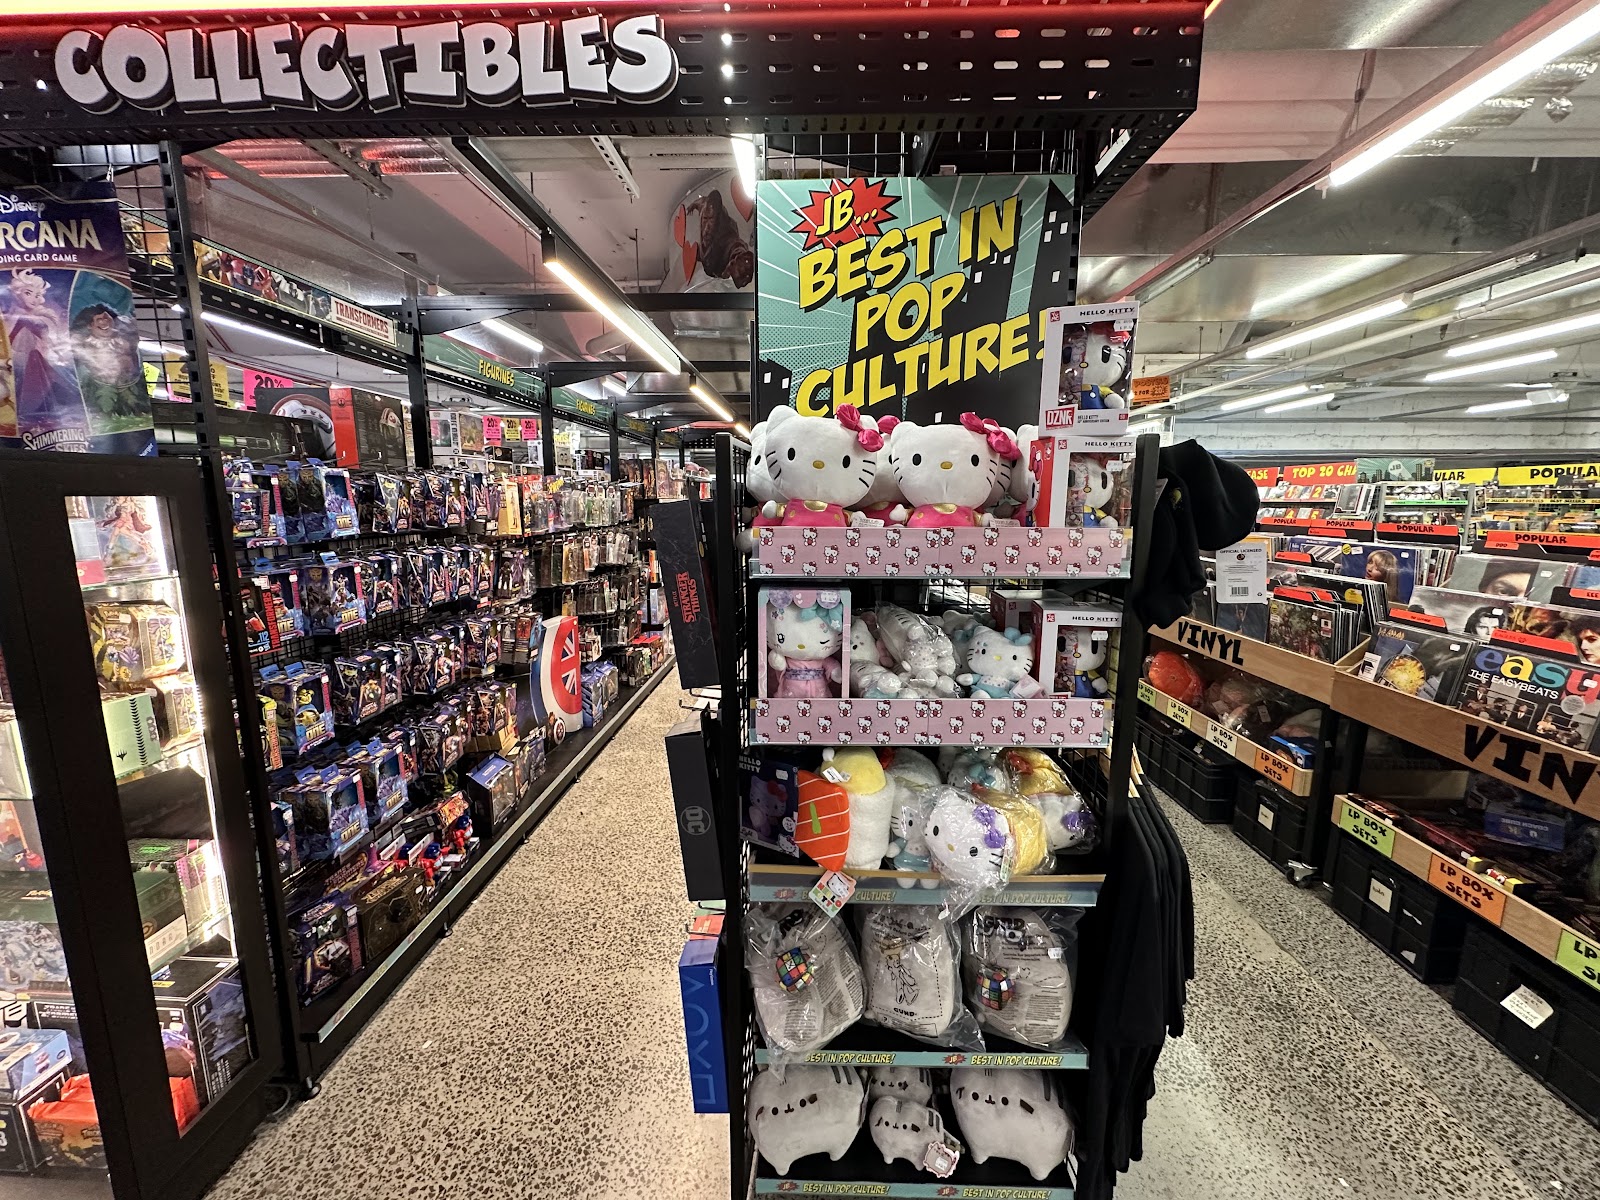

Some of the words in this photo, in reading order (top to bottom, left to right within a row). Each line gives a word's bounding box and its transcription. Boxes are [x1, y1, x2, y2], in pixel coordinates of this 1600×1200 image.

[54, 14, 677, 110] COLLECTIBLES
[24, 253, 49, 262] CARD
[52, 253, 78, 262] GAME
[798, 215, 945, 310] BEST
[958, 194, 1020, 264] IN
[335, 300, 389, 333] TRANSFORMERS
[855, 271, 966, 352] POP
[478, 359, 515, 387] FIGURINES
[22, 428, 85, 451] SHIMMERING
[1292, 466, 1315, 479] TOP
[1319, 465, 1334, 477] 20
[1530, 465, 1600, 479] POPULA
[1313, 486, 1322, 498] 2
[1396, 525, 1435, 533] POPULAR
[1515, 533, 1567, 544] POPULAR
[675, 570, 697, 624] STRANGER
[686, 578, 701, 613] THINGS
[262, 591, 280, 649] TRANSFORMERS
[1178, 620, 1244, 666] VINYL
[1469, 669, 1491, 683] THE
[1491, 674, 1560, 700] EASYBEATS
[1170, 701, 1177, 709] LP
[1178, 705, 1189, 716] BOX
[1172, 711, 1185, 723] SETS
[1210, 724, 1218, 733] LP
[1219, 729, 1233, 742] BOX
[1212, 735, 1228, 749] SETS
[738, 762, 761, 774] KITTY
[1261, 752, 1270, 762] LP
[1272, 758, 1289, 773] BOX
[1464, 723, 1600, 805] VIN
[1263, 765, 1282, 781] SETS
[1348, 808, 1360, 820] LP
[1363, 817, 1387, 837] BOX
[1352, 824, 1378, 845] SETS
[1440, 862, 1456, 877] LP
[1461, 874, 1495, 901] BOX
[855, 888, 897, 902] CULTURE!
[1445, 881, 1482, 909] SETS
[1573, 940, 1598, 960] LP
[1581, 966, 1600, 987] S
[893, 1007, 915, 1018] GUND
[828, 1053, 837, 1063] IN
[839, 1053, 856, 1063] POP
[856, 1053, 896, 1064] CULTURE!
[970, 1055, 993, 1065] BEST
[994, 1055, 1004, 1065] IN
[1004, 1056, 1021, 1065] POP
[1022, 1056, 1064, 1066] CULTURE!
[803, 1183, 824, 1192] BEST
[824, 1184, 834, 1193] IN
[835, 1184, 852, 1193] POP
[852, 1185, 891, 1195] CULTURE!
[963, 1188, 985, 1198] BEST
[985, 1189, 996, 1198] IN
[996, 1190, 1013, 1198] POP
[1012, 1190, 1052, 1200] CULTURE!
